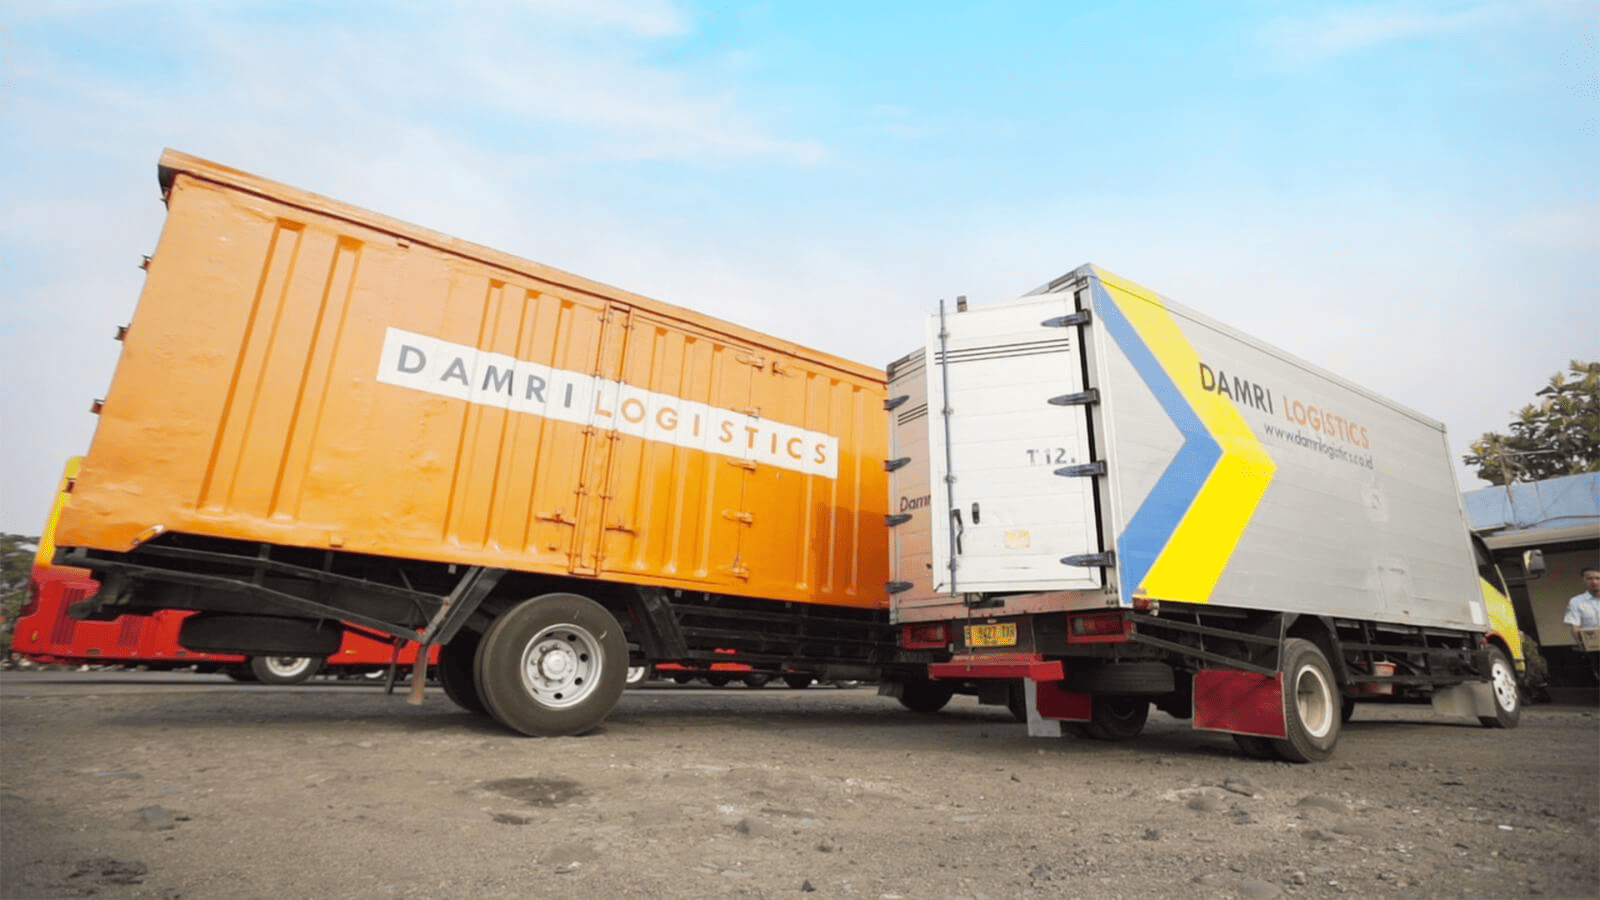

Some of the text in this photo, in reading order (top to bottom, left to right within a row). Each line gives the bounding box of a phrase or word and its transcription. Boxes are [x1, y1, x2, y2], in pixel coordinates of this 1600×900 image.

[397, 344, 828, 464] DAMRI LOGISTICS
[1199, 362, 1372, 449] DAMRI LOGISTICS
